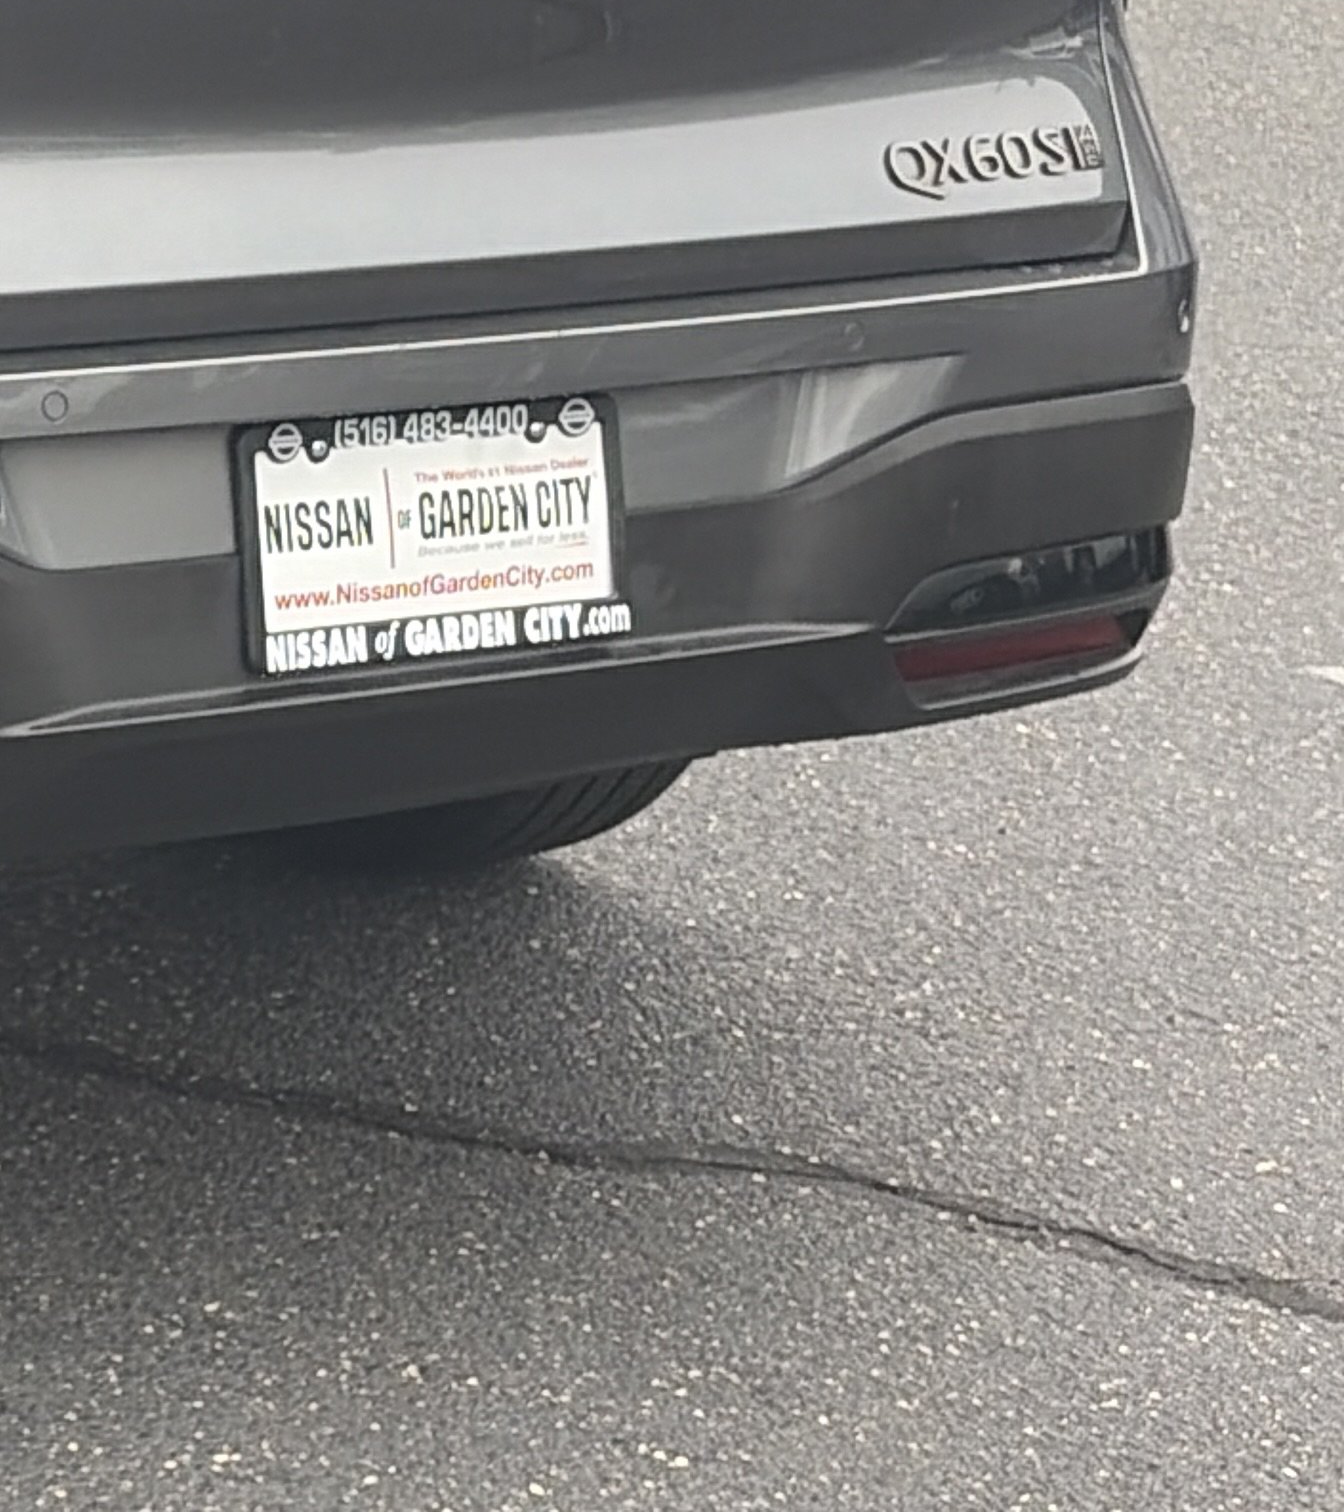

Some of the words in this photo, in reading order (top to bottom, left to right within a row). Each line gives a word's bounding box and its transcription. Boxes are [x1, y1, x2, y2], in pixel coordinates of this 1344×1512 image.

[334, 417, 395, 447] (516)
[403, 405, 528, 443] 483-4400
[264, 496, 374, 554] NISSAN
[418, 482, 529, 540] GARDEN
[536, 474, 591, 528] CITY
[275, 560, 594, 610] www.NissanofGardenCity.com
[266, 624, 369, 673] NISSAN
[375, 620, 400, 660] of
[405, 609, 516, 656] GARDEN
[524, 602, 632, 644] CITY.com
